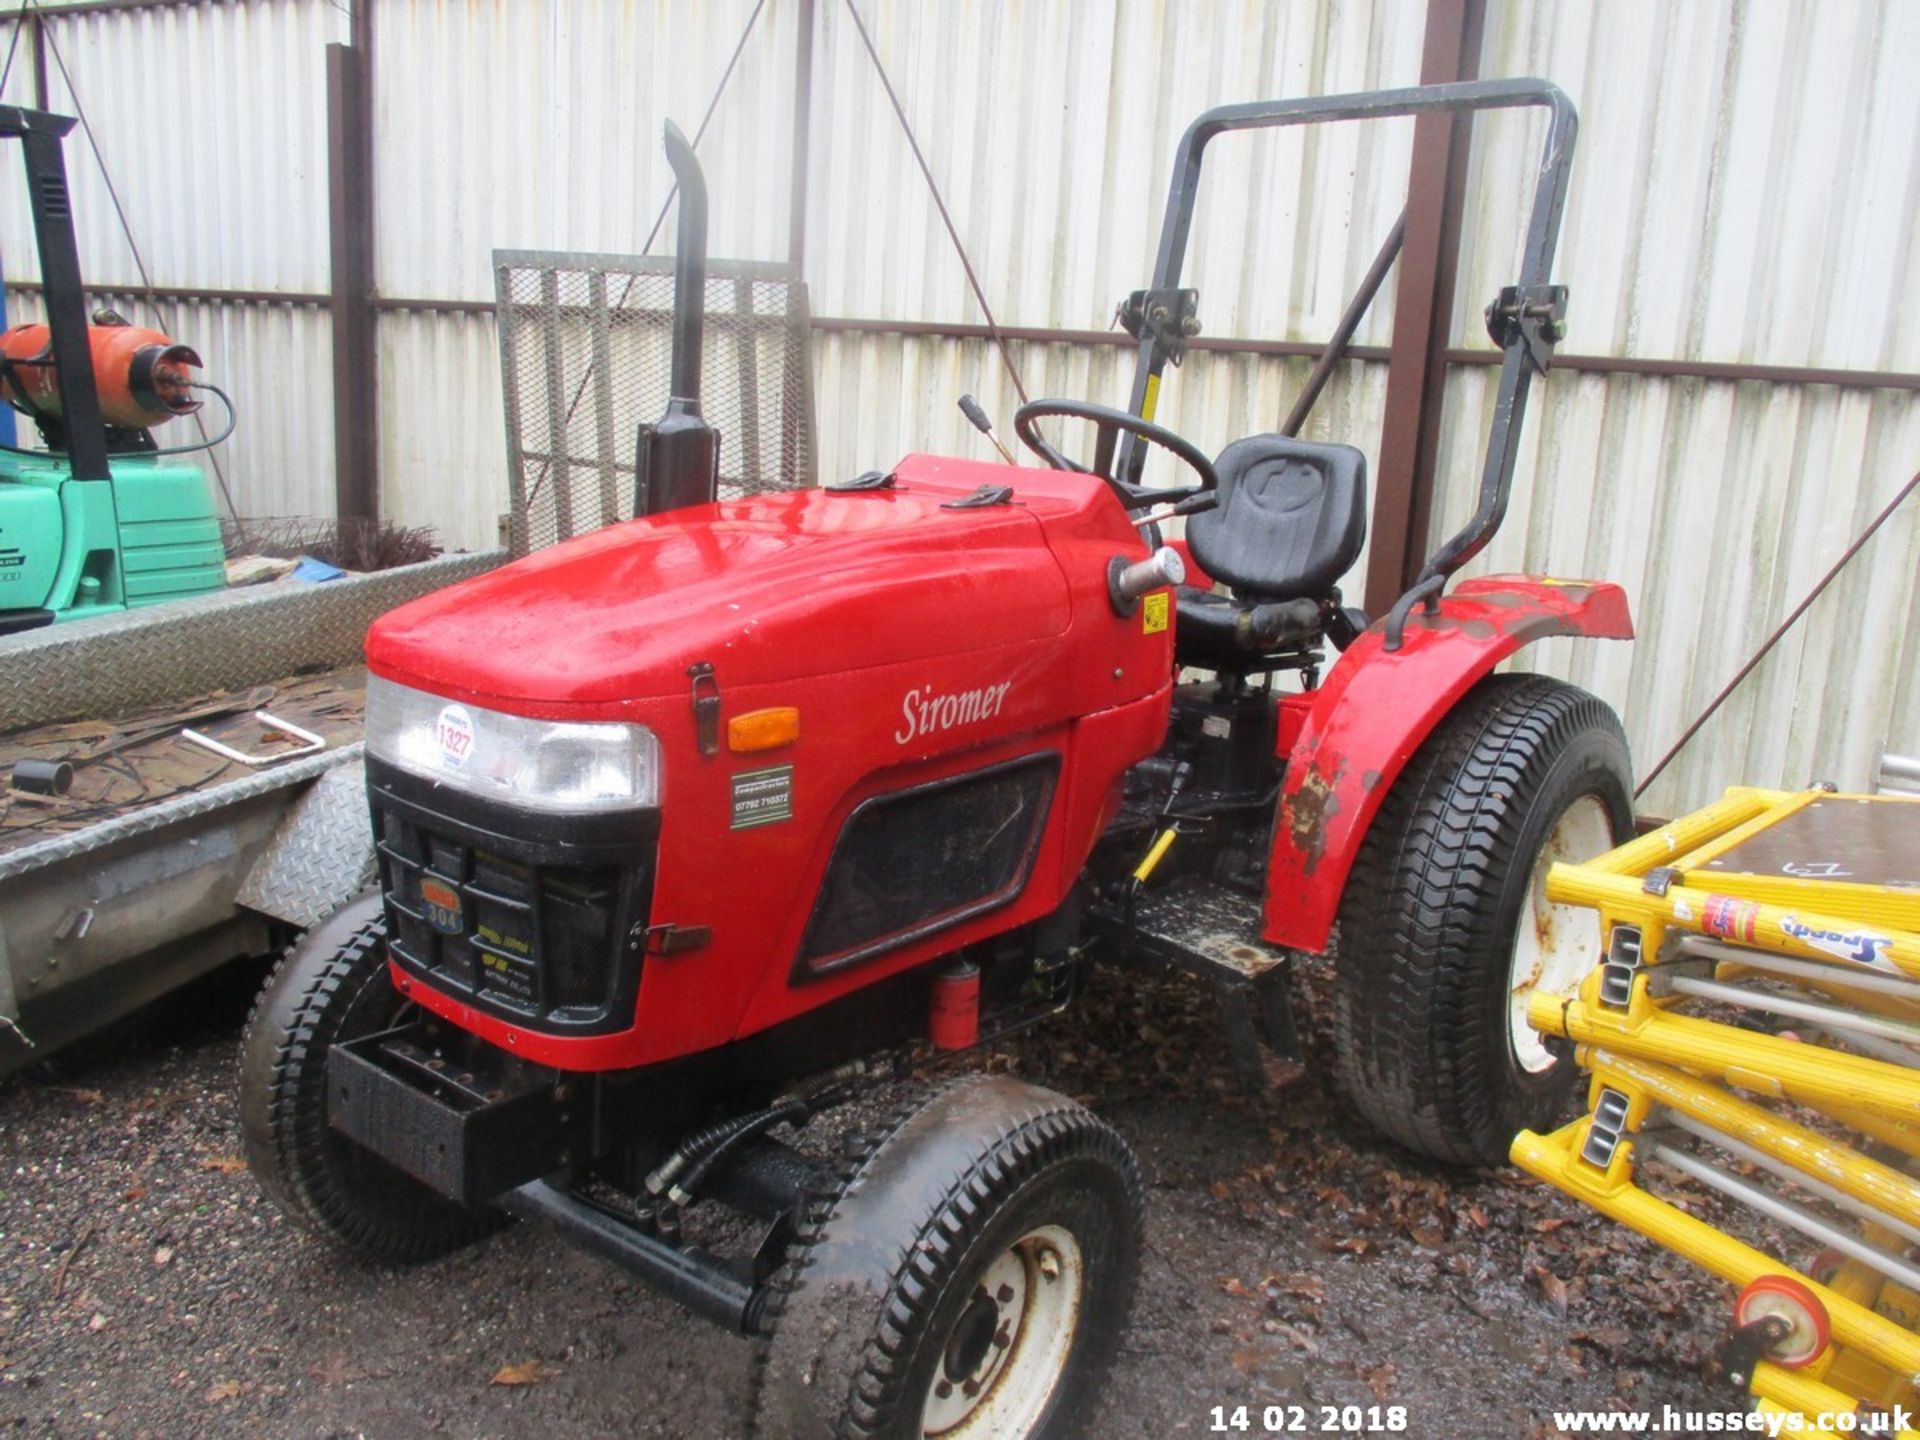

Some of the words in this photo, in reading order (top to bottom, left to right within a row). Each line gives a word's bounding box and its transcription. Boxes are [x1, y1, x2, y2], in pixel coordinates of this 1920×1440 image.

[896, 683, 1011, 744] Siromer
[440, 724, 471, 756] 1327
[429, 903, 457, 930] 304
